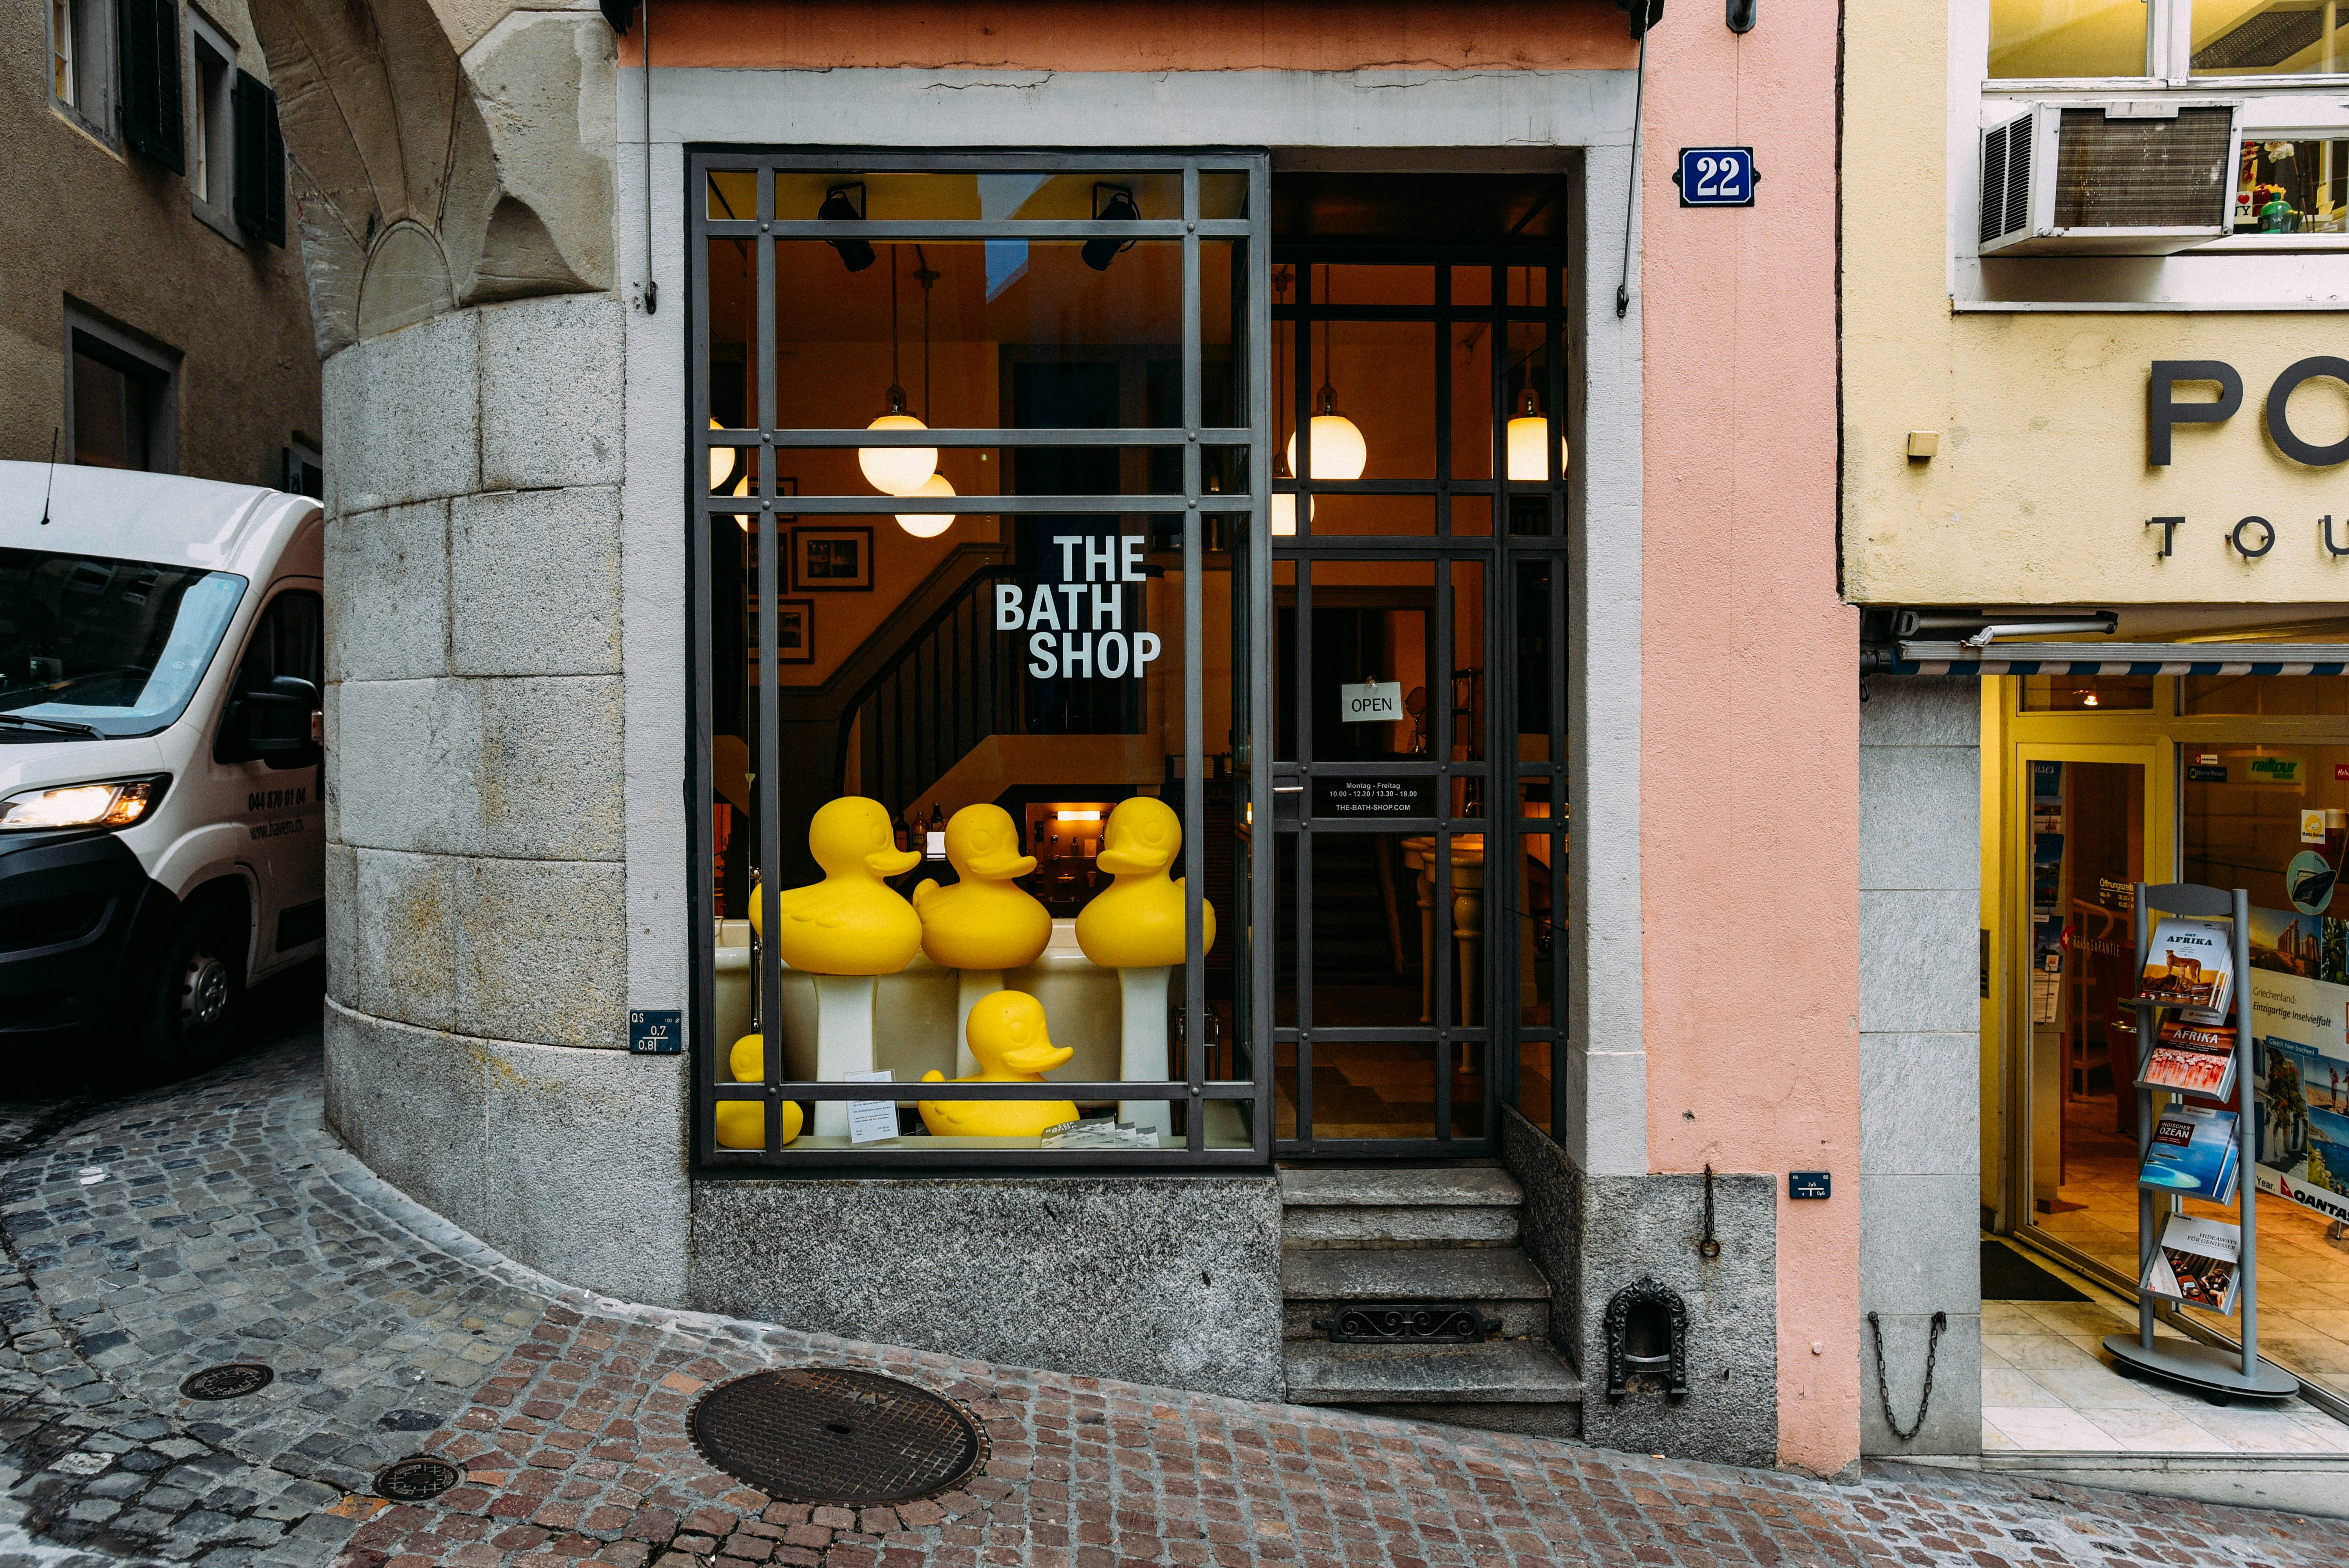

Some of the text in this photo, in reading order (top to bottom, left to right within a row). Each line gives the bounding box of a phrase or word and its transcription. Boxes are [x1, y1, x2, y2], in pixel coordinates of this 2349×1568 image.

[1697, 157, 1739, 196] 22
[2151, 356, 2349, 465] PO
[1053, 535, 1146, 581] THE
[996, 584, 1121, 630] BATH
[1029, 632, 1161, 679] SHOP
[1351, 698, 1392, 712] OPEN
[2251, 757, 2297, 773] railtour
[249, 787, 306, 811] 044 870 01 04
[2166, 936, 2212, 946] AFRIKA
[2253, 987, 2296, 1004] Griechenland:
[632, 1013, 644, 1023] QS
[2253, 1001, 2331, 1027] Einzigartige Inselvielfalt
[651, 1026, 666, 1036] 0,7
[2173, 1030, 2218, 1044] AFRIKA
[638, 1040, 653, 1050] 0,8
[2269, 1038, 2315, 1055] Gleich hier buchen!
[2160, 1127, 2189, 1138] OZEAN
[2161, 1122, 2190, 1130] INDISCHER
[2256, 1176, 2276, 1191] Year.
[2199, 1233, 2238, 1245] HIDEAWAYS
[2201, 1239, 2236, 1250] GENIESSER
